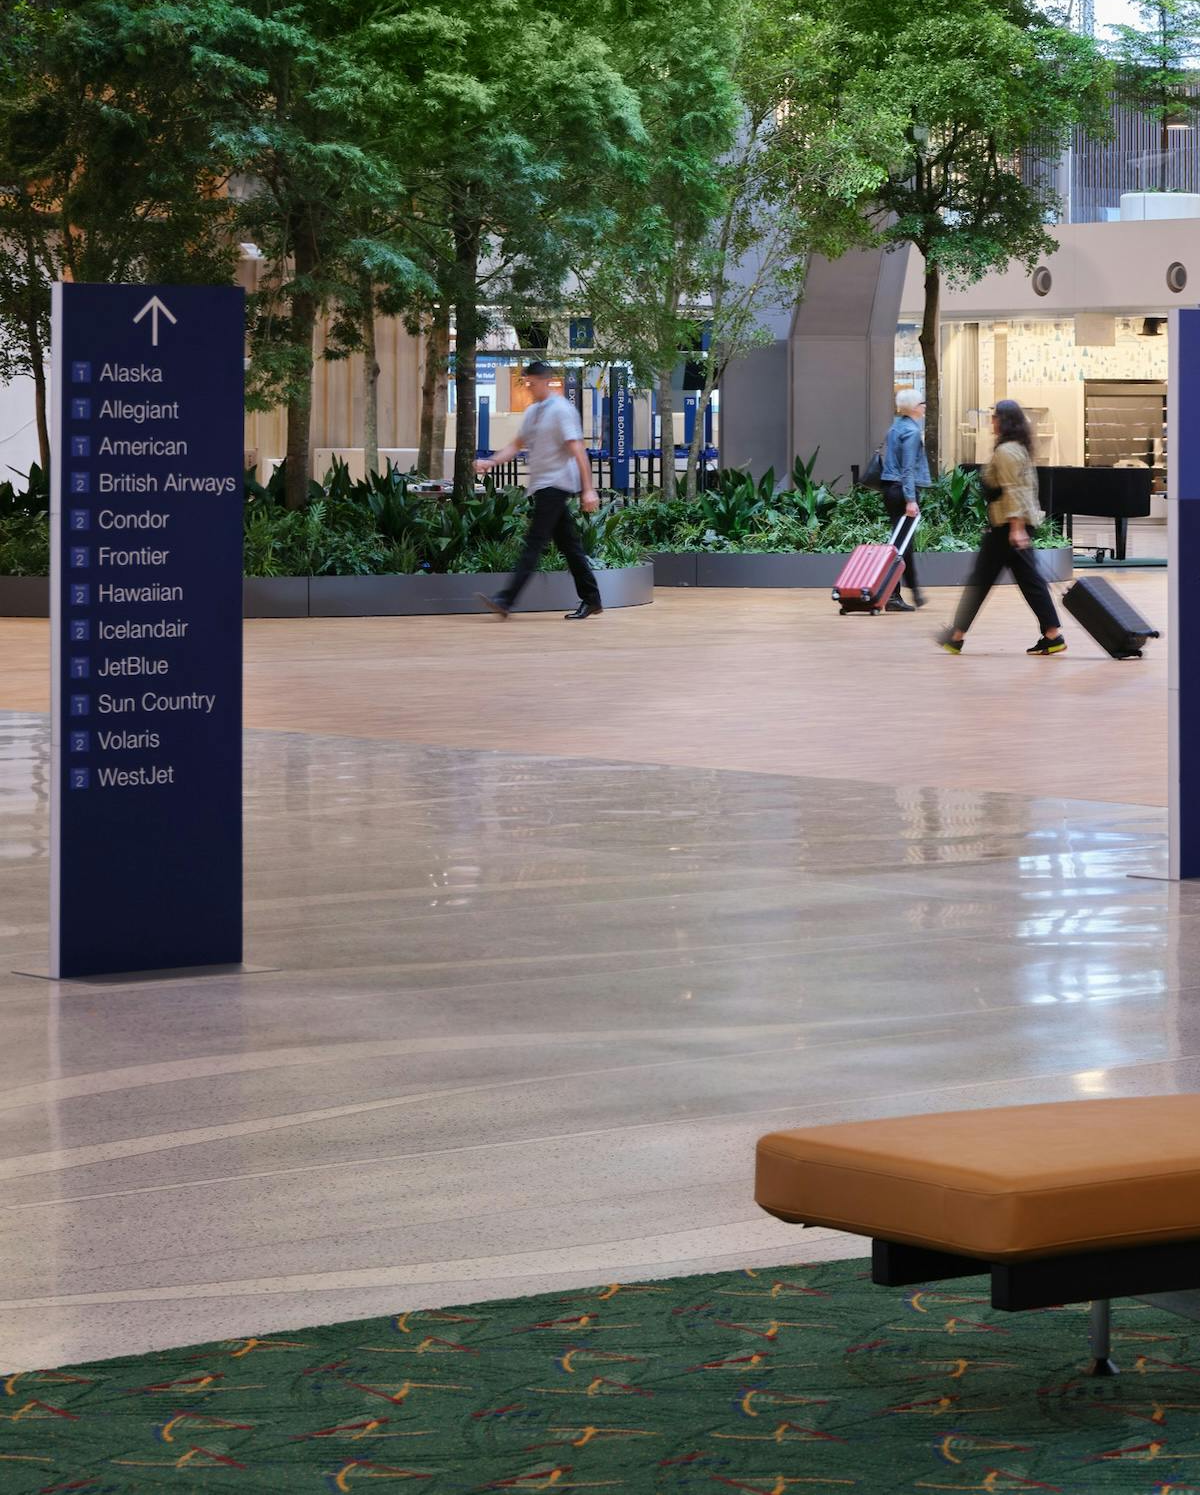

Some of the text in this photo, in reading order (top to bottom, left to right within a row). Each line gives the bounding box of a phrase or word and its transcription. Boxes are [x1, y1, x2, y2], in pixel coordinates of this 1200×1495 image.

[78, 363, 163, 382] 1 Alaska
[78, 400, 179, 423] 1 Allegiant
[78, 437, 188, 456] 1 American
[76, 473, 236, 496] 2 British Airways
[76, 510, 170, 529] 2 Condor
[76, 547, 169, 566] 2 Frontier
[76, 583, 183, 602] 2 Hawaiian
[76, 619, 188, 639] 2 Icelandair
[78, 656, 169, 676] 1 JetBlue
[78, 691, 216, 713] 1 Sun Country
[76, 729, 160, 749] 2 Volaris
[76, 765, 174, 786] 2 WestJet
